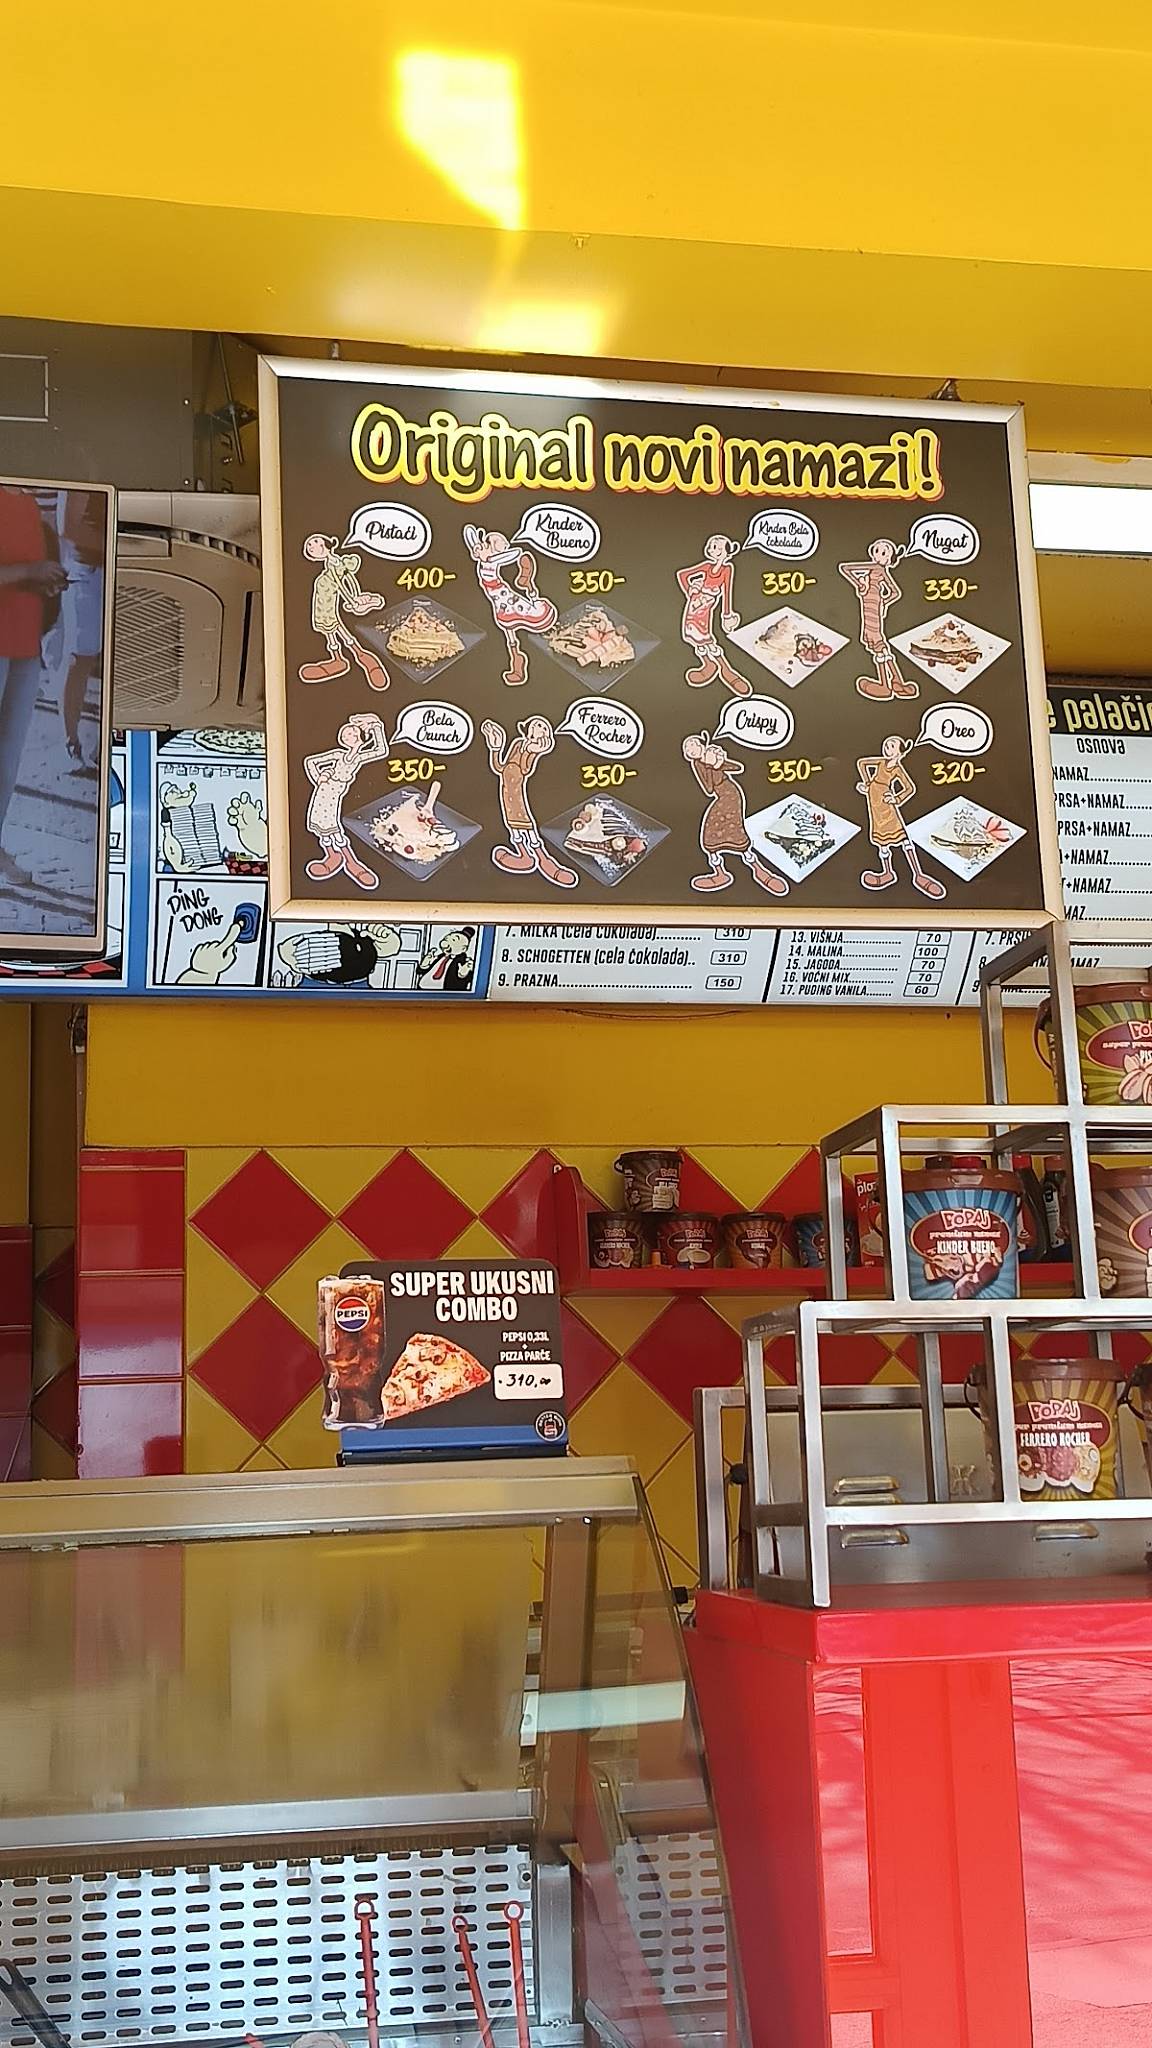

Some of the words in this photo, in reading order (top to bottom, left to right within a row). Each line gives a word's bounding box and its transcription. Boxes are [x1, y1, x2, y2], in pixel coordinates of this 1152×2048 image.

[351, 403, 595, 502] Original
[604, 424, 724, 496] novi
[723, 428, 944, 502] namazi!
[535, 513, 584, 533] Kinder
[759, 520, 787, 535] Kinder
[788, 521, 809, 535] Bela
[546, 531, 590, 549] Bueno
[921, 529, 968, 554] Nugat
[397, 567, 456, 591] 400-
[569, 570, 626, 593] 350-
[762, 571, 816, 595] 350-
[924, 578, 979, 601] 330-
[422, 709, 455, 727] Bela
[578, 706, 627, 727] Ferrero
[735, 710, 778, 736] Crispy
[416, 724, 461, 743] Crunch
[585, 724, 633, 745] Rocher
[941, 719, 976, 739] Oreo
[1077, 737, 1126, 755] osnova
[387, 758, 447, 783] 350-
[580, 763, 638, 788] 350-
[767, 759, 823, 783] 350-
[930, 760, 987, 785] 320-
[179, 906, 223, 932] DONG
[520, 926, 558, 938] MILKA
[791, 931, 807, 943] 13.
[926, 933, 942, 943] 70
[501, 948, 513, 963] 8.
[517, 948, 591, 964] SCHOGETTEN
[594, 946, 625, 965] (cela
[718, 953, 740, 964] 310
[788, 945, 804, 957] 14.
[918, 947, 939, 957] 100
[785, 958, 801, 970] 15.
[921, 960, 936, 970] 70
[498, 973, 510, 986] 9.
[713, 978, 736, 988] 150
[782, 971, 798, 983] 16.
[918, 973, 932, 982] 70
[780, 984, 795, 996] 17.
[914, 985, 929, 995] 60
[941, 1208, 992, 1230] POPAJ
[936, 1240, 969, 1254] KINDER
[970, 1240, 997, 1254] BUENO
[389, 1271, 466, 1297] SUPER
[469, 1269, 555, 1296] UKUSNI
[336, 1309, 369, 1319] PEPSI
[434, 1296, 519, 1323] COMBO
[502, 1331, 527, 1342] PEPSI
[500, 1350, 524, 1362] PIZZA
[1028, 1399, 1081, 1422] POPAJ
[1020, 1431, 1058, 1447] FERRERO
[1059, 1431, 1091, 1447] ROCHER
